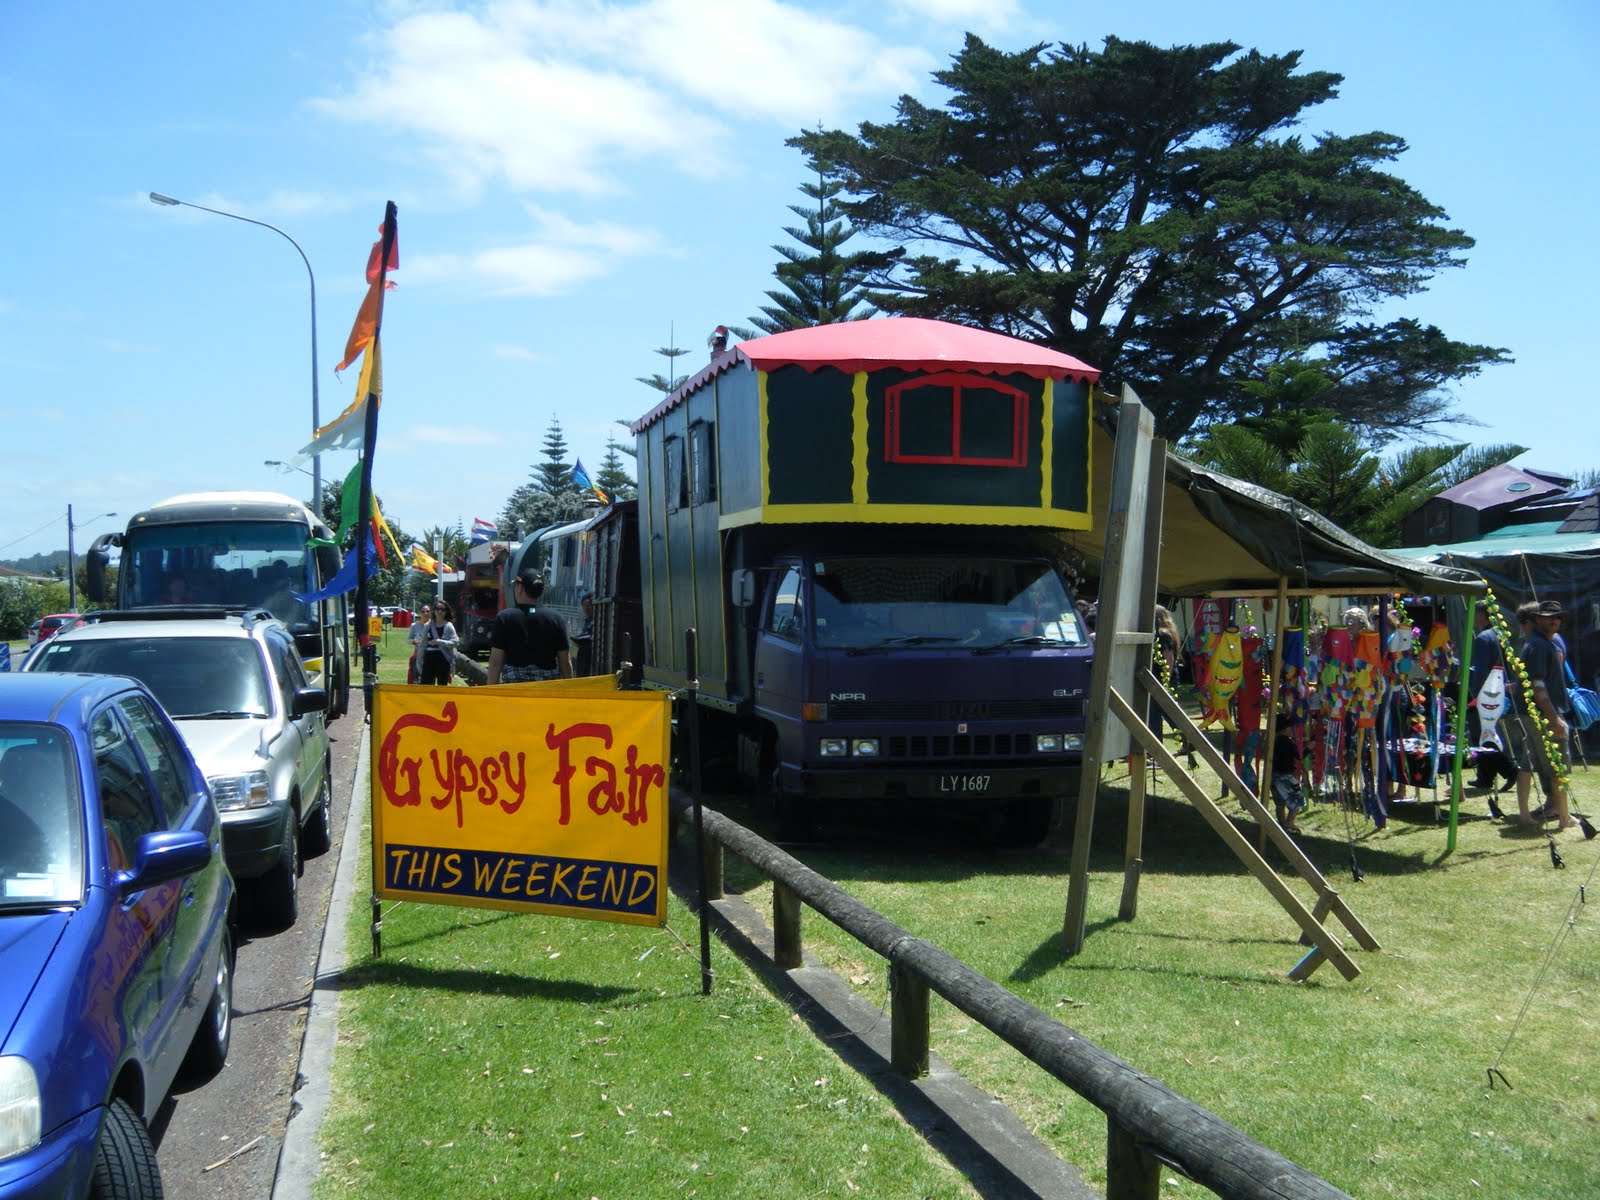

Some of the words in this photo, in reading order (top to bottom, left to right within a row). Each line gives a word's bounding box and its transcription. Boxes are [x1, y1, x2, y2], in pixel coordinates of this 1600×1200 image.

[830, 693, 866, 701] NPR
[378, 701, 526, 828] Gypsy
[545, 722, 665, 826] Fair
[390, 850, 463, 889] THIS
[473, 856, 656, 906] WEEKEND
